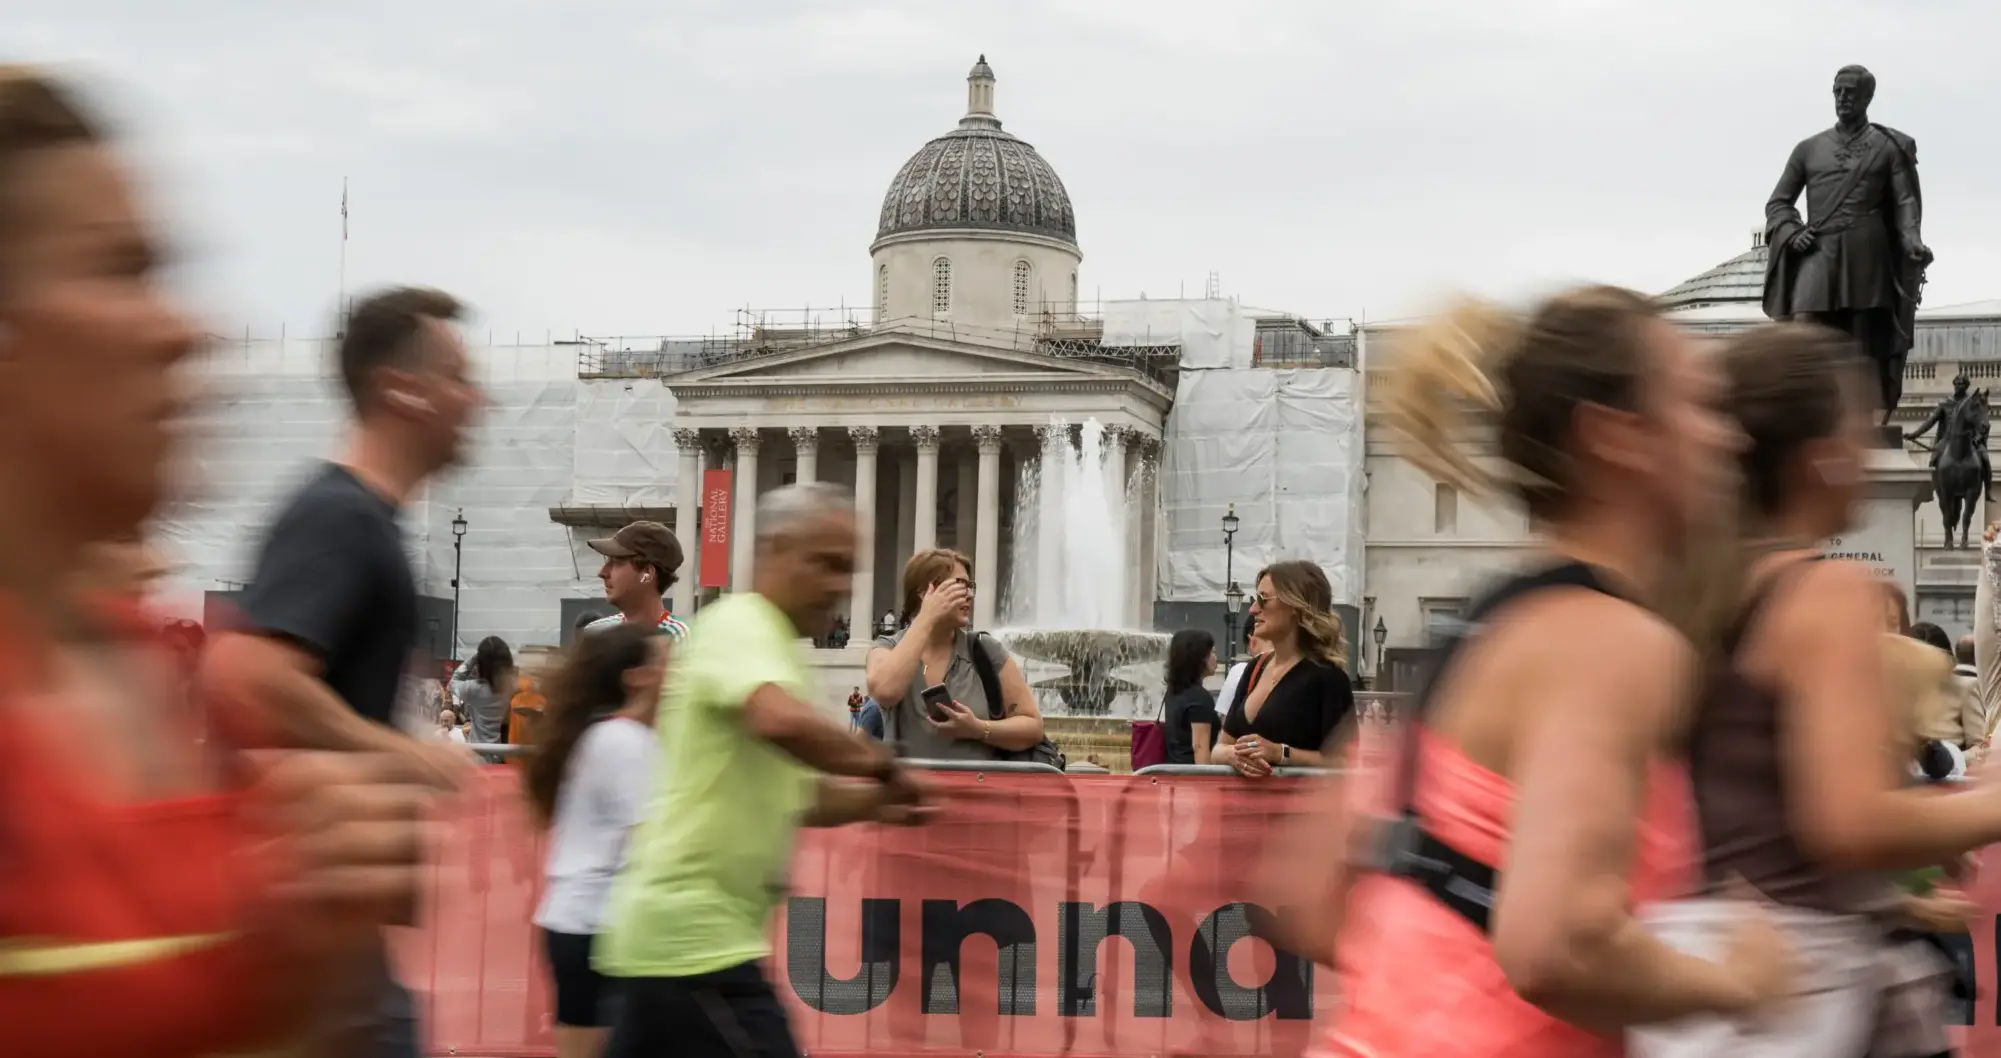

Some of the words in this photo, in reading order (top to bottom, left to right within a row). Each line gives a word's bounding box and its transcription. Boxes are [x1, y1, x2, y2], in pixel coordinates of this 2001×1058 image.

[708, 488, 718, 542] NATIONAL
[717, 489, 728, 543] GALLERY
[1829, 537, 1842, 546] TO
[1831, 552, 1885, 562] GENERAL
[787, 896, 1314, 1021] unna
